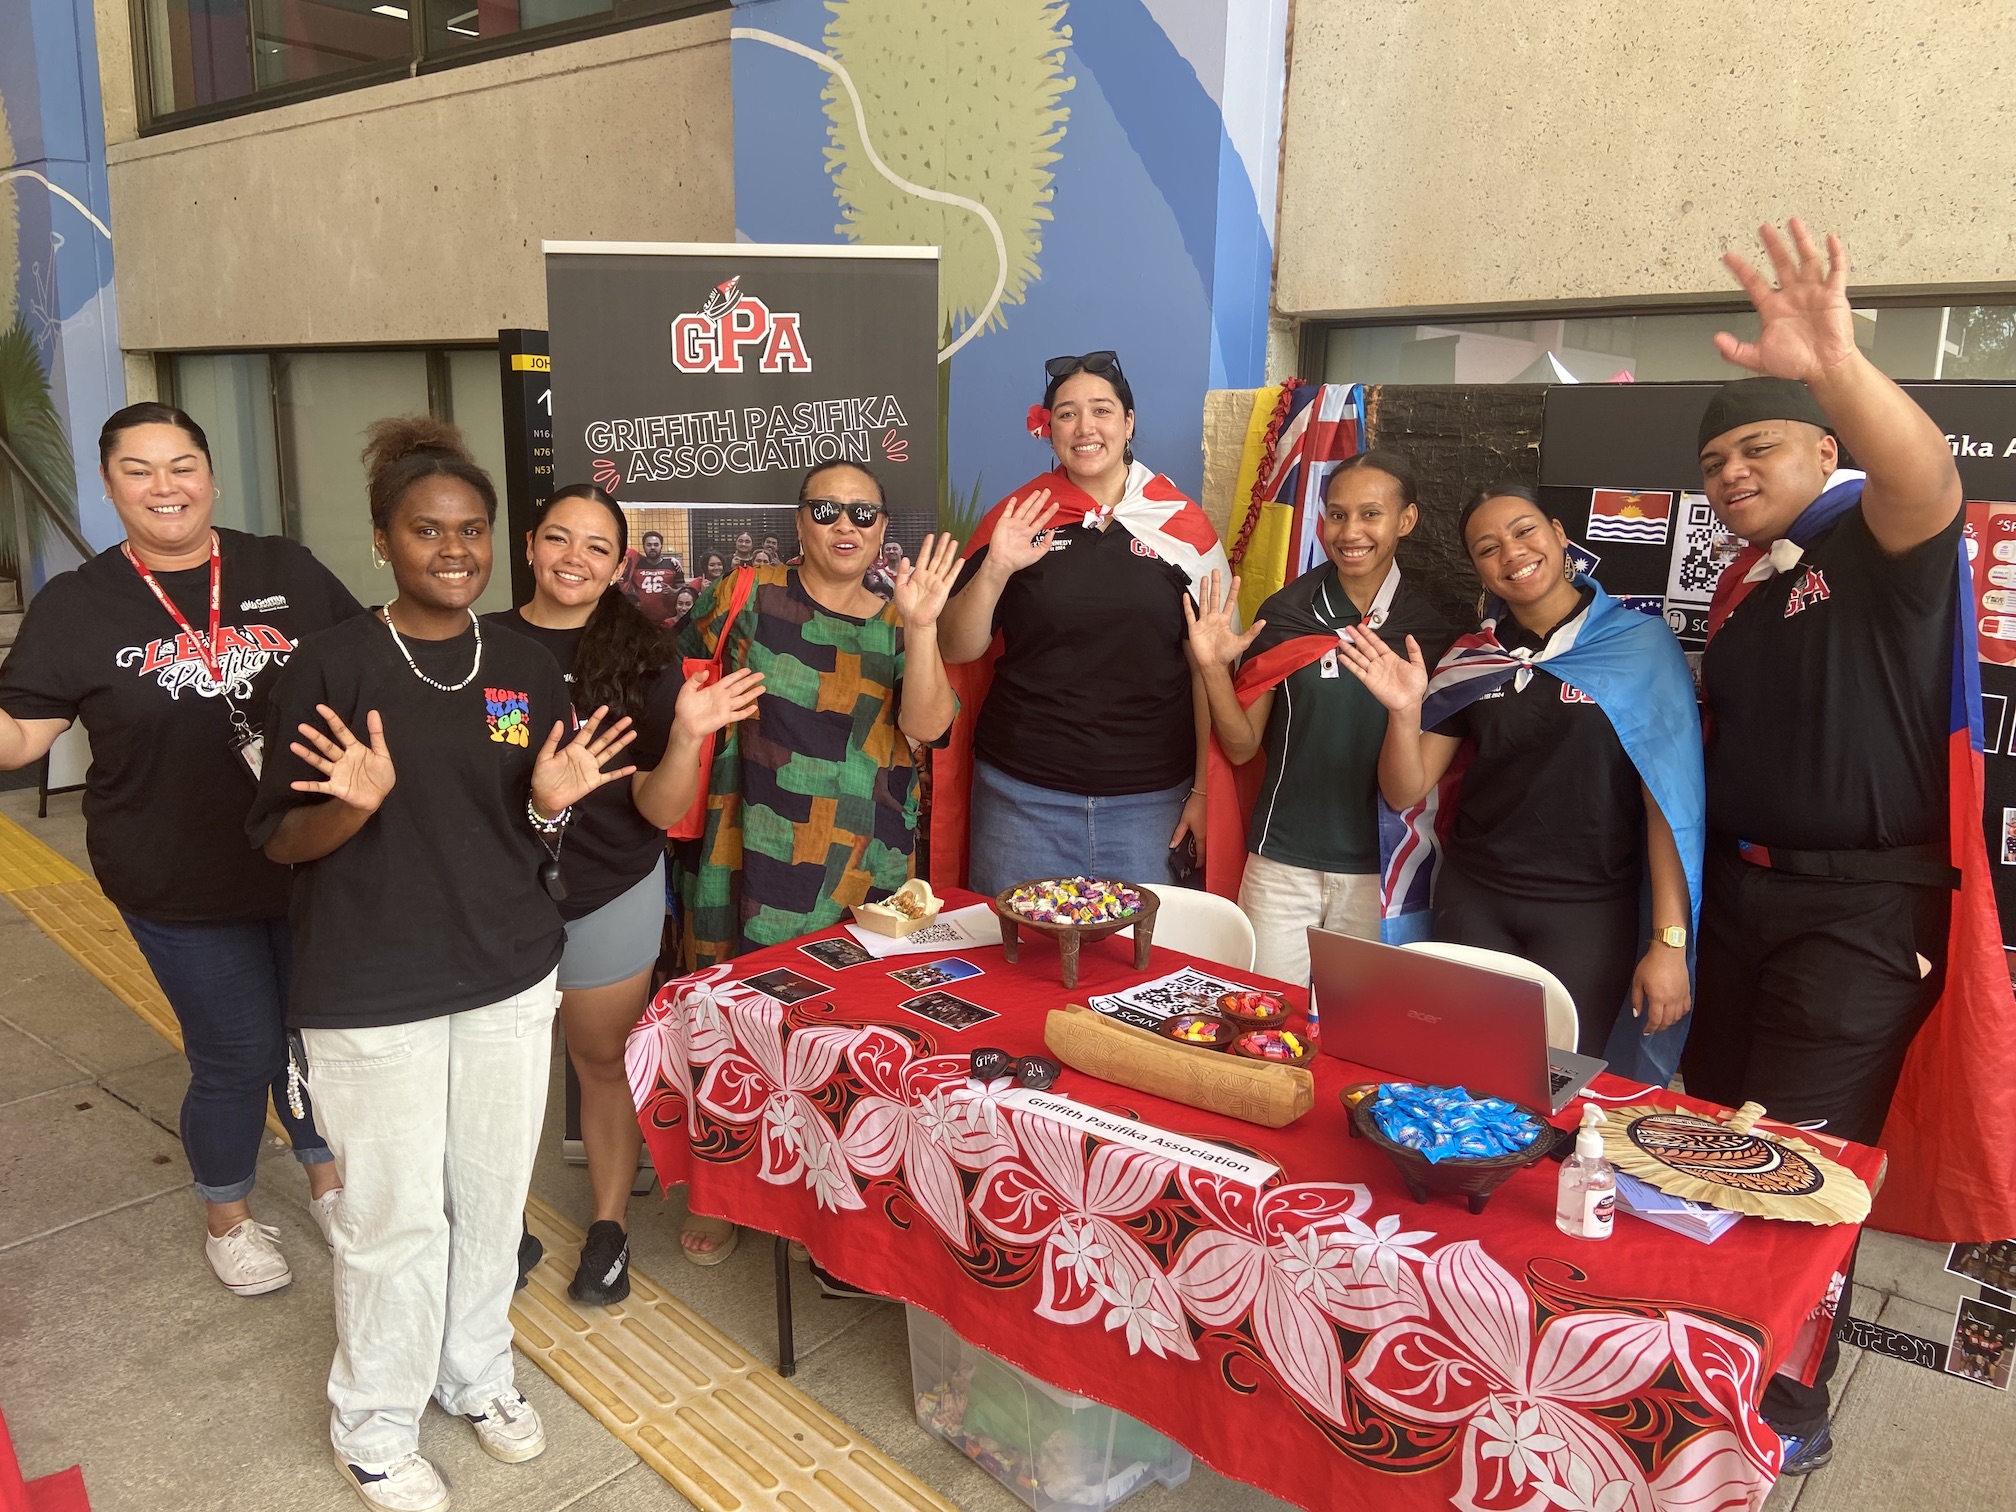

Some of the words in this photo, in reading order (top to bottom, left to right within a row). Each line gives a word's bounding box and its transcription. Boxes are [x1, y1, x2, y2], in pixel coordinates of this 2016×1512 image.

[671, 296, 812, 374] GPA
[533, 429, 550, 438] N16
[585, 410, 737, 454] GRIFFITH
[744, 395, 908, 440] PASIFIKA
[534, 448, 551, 457] N76
[626, 431, 871, 484] ASSOCIATION
[534, 466, 551, 475] N53
[814, 502, 834, 521] GPA
[857, 508, 873, 521] 24
[1784, 567, 1831, 619] GPA
[139, 624, 294, 677] LEAD
[157, 648, 271, 700] Pafika
[497, 709, 522, 730] GO
[487, 723, 530, 748] YET
[1116, 1011, 1159, 1028] SCAN
[1407, 1009, 1442, 1024] acer
[976, 1053, 999, 1068] GPA
[1025, 1062, 1045, 1077] 24
[1027, 1096, 1083, 1120] Griffith
[1086, 1115, 1148, 1141] Pasifika
[1150, 1137, 1251, 1173] Association
